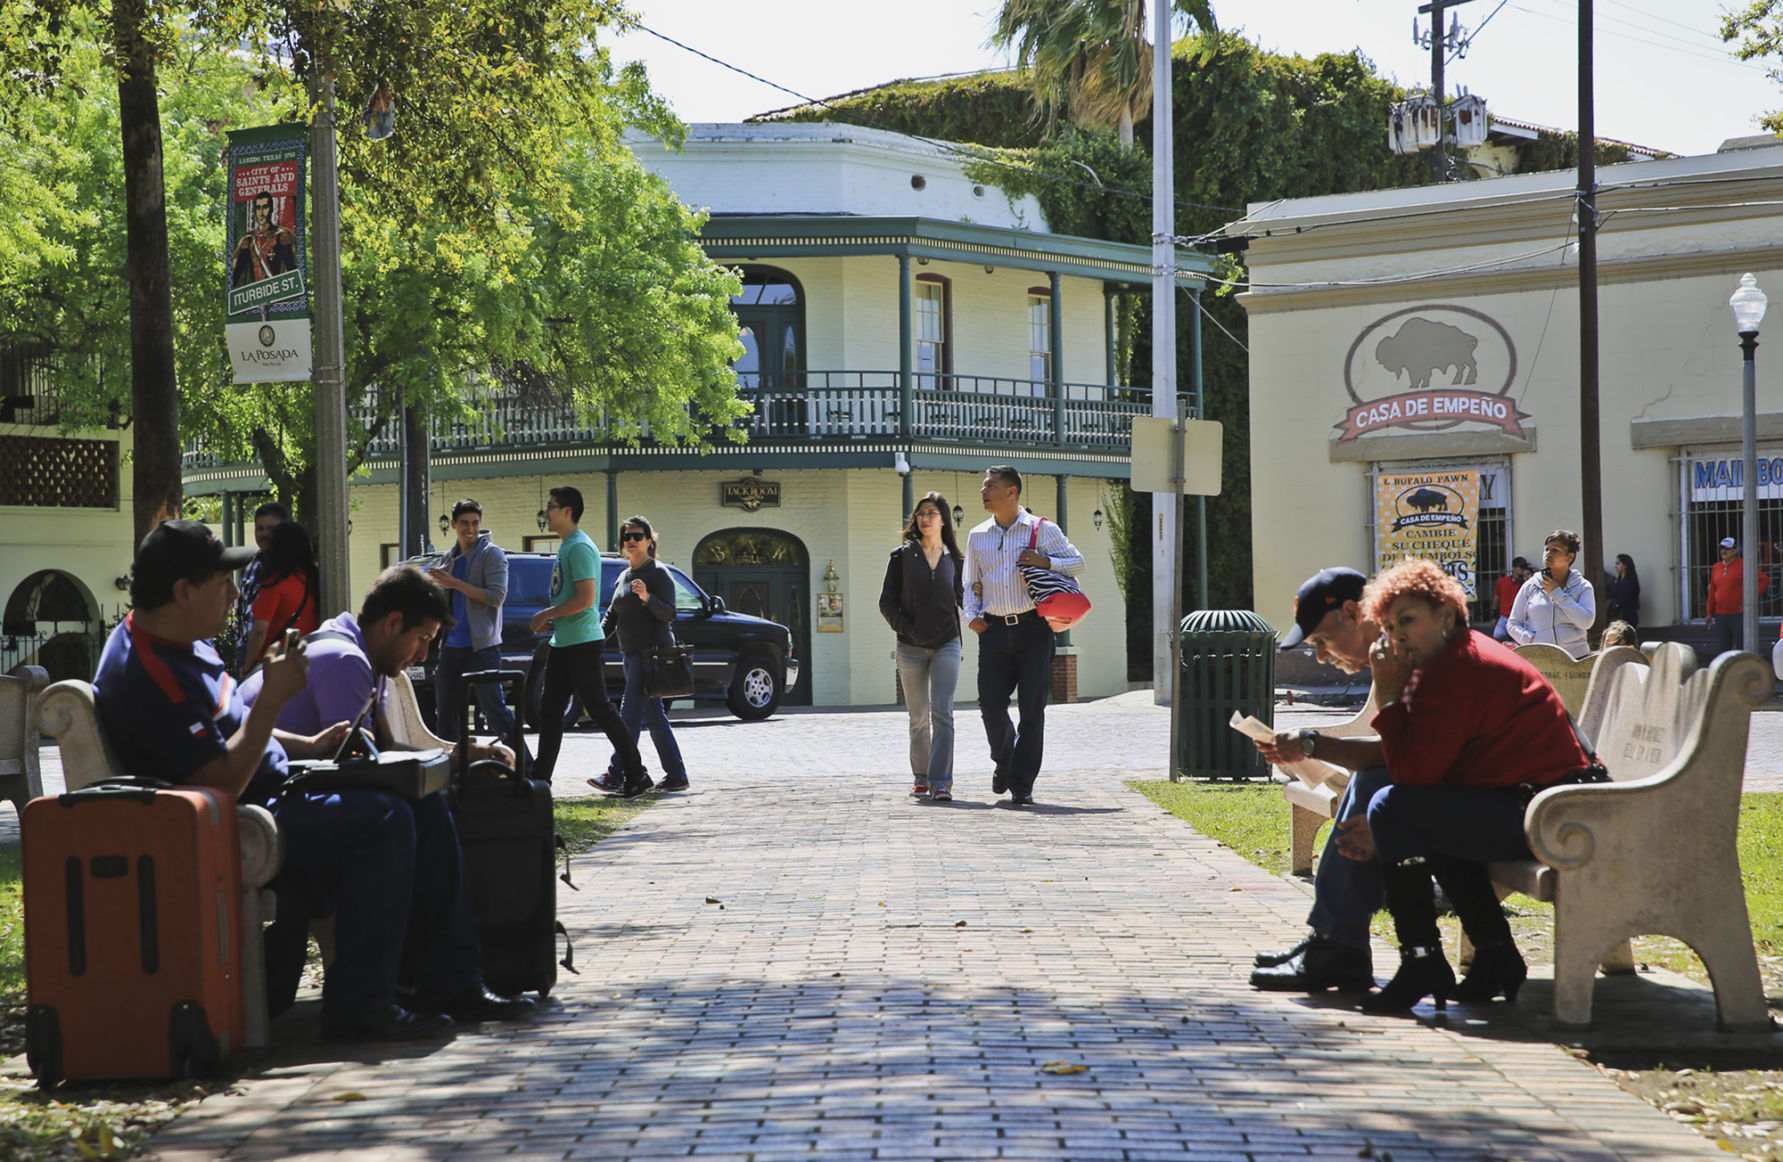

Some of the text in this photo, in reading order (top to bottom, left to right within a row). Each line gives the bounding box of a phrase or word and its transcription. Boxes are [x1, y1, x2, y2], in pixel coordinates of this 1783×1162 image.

[251, 167, 269, 175] CITY
[236, 172, 295, 187] SAINTS AND
[238, 182, 289, 196] GENERALS
[234, 277, 299, 306] ITURBIDE ST.
[241, 349, 299, 363] LA POSADA
[1355, 396, 1507, 428] CASA DE EMPEÑO
[1394, 477, 1433, 486] BUFALO
[1437, 474, 1468, 483] PAWN
[1400, 516, 1419, 525] CASA
[1406, 529, 1456, 538] CAMBIE
[1392, 540, 1471, 550] SU CHEQUE
